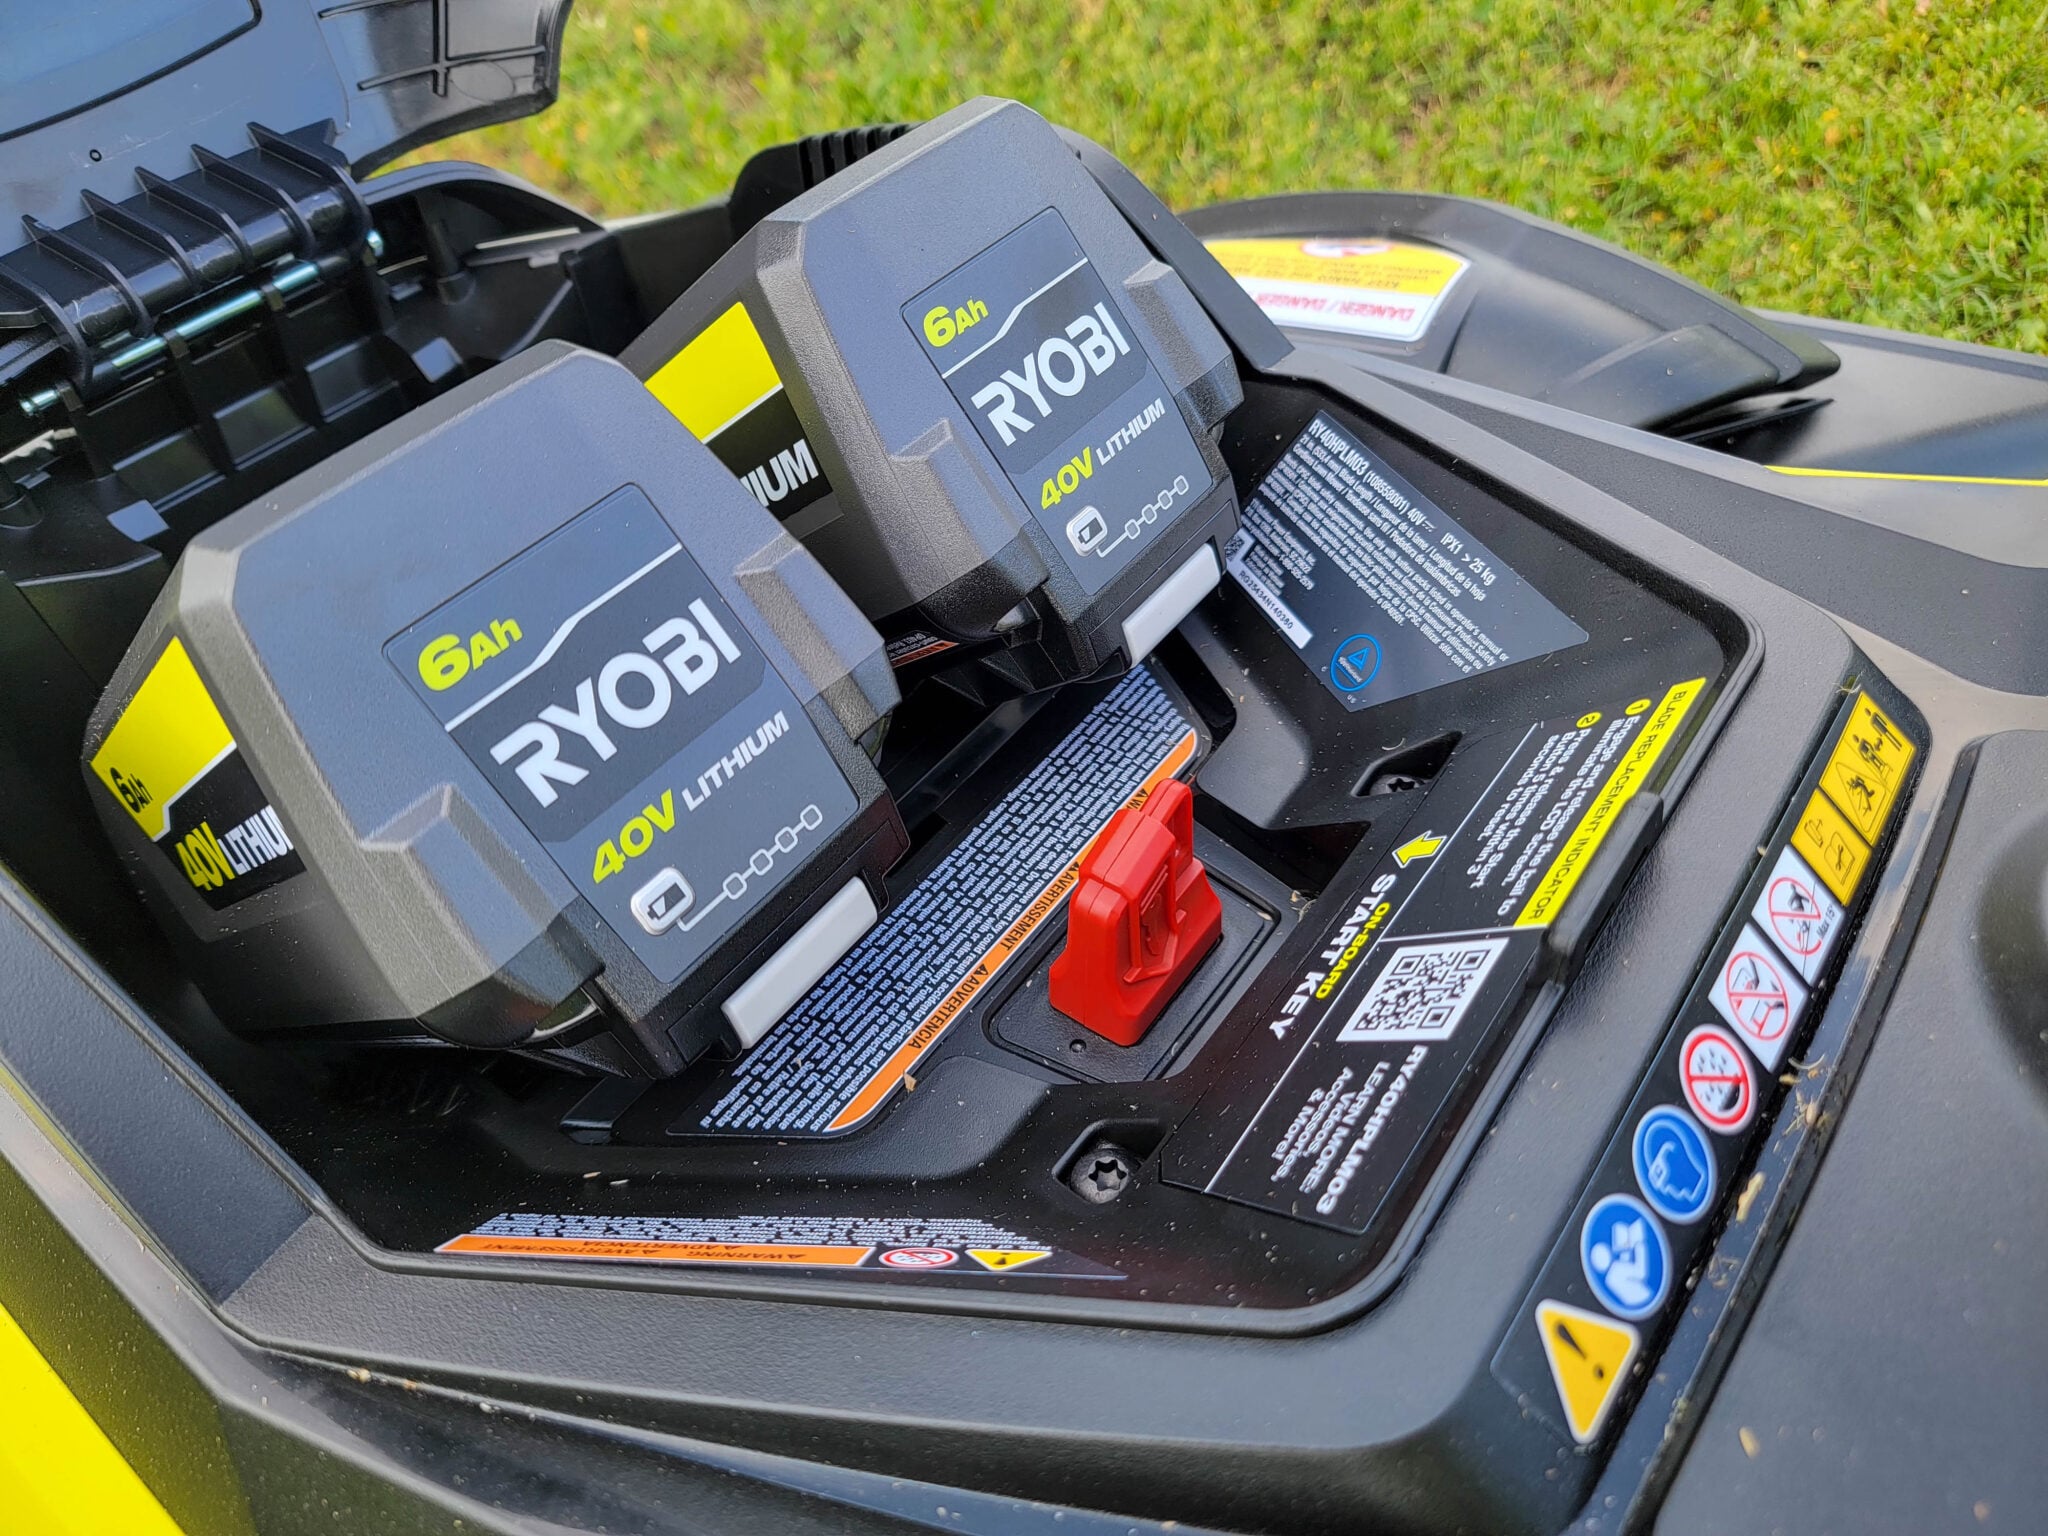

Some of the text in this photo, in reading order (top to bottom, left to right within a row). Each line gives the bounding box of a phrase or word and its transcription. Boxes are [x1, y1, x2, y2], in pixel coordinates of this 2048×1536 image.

[924, 300, 988, 347] 6Ah
[971, 302, 1130, 446] RYOBI
[1041, 398, 1165, 509] 40V LITHIUM
[1308, 419, 1369, 475] RY40HPLM03
[1362, 470, 1410, 514] (108558001)
[1407, 508, 1426, 525] 40V
[1440, 532, 1463, 554] IPX1
[1468, 558, 1485, 573] 25
[1480, 567, 1496, 585] kg
[1352, 480, 1373, 501] Length
[1373, 499, 1401, 525] Longueur
[1411, 532, 1428, 550] lame
[1429, 548, 1458, 575] Longitud
[1454, 572, 1465, 582] de
[1462, 577, 1471, 588] la
[1469, 583, 1485, 601] hoja
[1389, 530, 1417, 557] Podadora
[1414, 554, 1425, 564] de
[1422, 559, 1461, 596] inalámbricas
[1423, 612, 1446, 633] manuel
[1472, 659, 1483, 669] ou
[1428, 601, 1496, 666] Consumer Product Safety
[1450, 608, 1480, 635] operator's
[1477, 633, 1502, 655] manual
[1499, 653, 1509, 661] or
[418, 618, 522, 691] 6Ah
[1451, 654, 1463, 666] con
[1462, 665, 1471, 673] el
[490, 598, 741, 807] RYOBI
[1558, 728, 1591, 763] Press
[1600, 715, 1640, 761] Engage
[1477, 734, 1559, 840] seconds to reset.
[1548, 766, 1563, 776] &
[1581, 764, 1604, 788] and
[110, 767, 153, 813] 6Ah
[592, 711, 789, 883] 40V LITHIUM
[1467, 731, 1576, 874] Button 5 times within 3
[1501, 718, 1625, 885] illuminate the LCD screen.
[1514, 778, 1553, 825] release
[1528, 690, 1687, 919] BLADE REPLACEMENT INDICATOR
[1546, 790, 1586, 840] release
[175, 805, 293, 890] 40V LITHIU
[1054, 843, 1063, 851] or
[1068, 836, 1084, 849] use.
[1497, 827, 1520, 850] the
[1529, 842, 1553, 866] the
[1026, 871, 1039, 881] Do
[1034, 851, 1056, 869] death.
[1041, 871, 1053, 879] to
[1048, 849, 1073, 871] Failure
[1470, 852, 1503, 888] Start
[1014, 881, 1028, 893] not
[1019, 879, 1044, 904] remove
[1509, 868, 1536, 895] bail
[993, 892, 1019, 917] tamper
[1003, 903, 1021, 920] start
[1497, 897, 1516, 915] to
[970, 932, 980, 942] or
[977, 917, 995, 932] with
[990, 919, 1008, 933] key
[908, 872, 1074, 1049] AVERTISSEMENT ADVERTENCIA
[954, 941, 972, 958] alter
[973, 933, 994, 954] could
[1269, 874, 1396, 1039] START KEY
[1316, 903, 1389, 998] ON-BOARD
[928, 957, 958, 984] battery.
[946, 973, 958, 982] in
[953, 952, 976, 974] result
[778, 880, 1016, 1129] fire. Do not short terminals. Retirer la clé de démarrage et la pile lorsque
[895, 1009, 907, 1022] all
[906, 985, 933, 1010] Follow
[911, 982, 949, 1021] accidental
[853, 1020, 900, 1066] instructions
[882, 1019, 914, 1050] starting
[869, 1049, 886, 1067] and
[832, 1066, 856, 1089] when
[838, 1064, 871, 1100] possible
[793, 1088, 834, 1128] removing,
[810, 1099, 840, 1131] serious
[1271, 1088, 1324, 1159] & More!
[1271, 1067, 1352, 1181] Accessories,
[1302, 1092, 1355, 1156] Videos,
[1299, 1062, 1389, 1192] LEARN MORE:
[1316, 1045, 1427, 1213] RY40HPLM03
